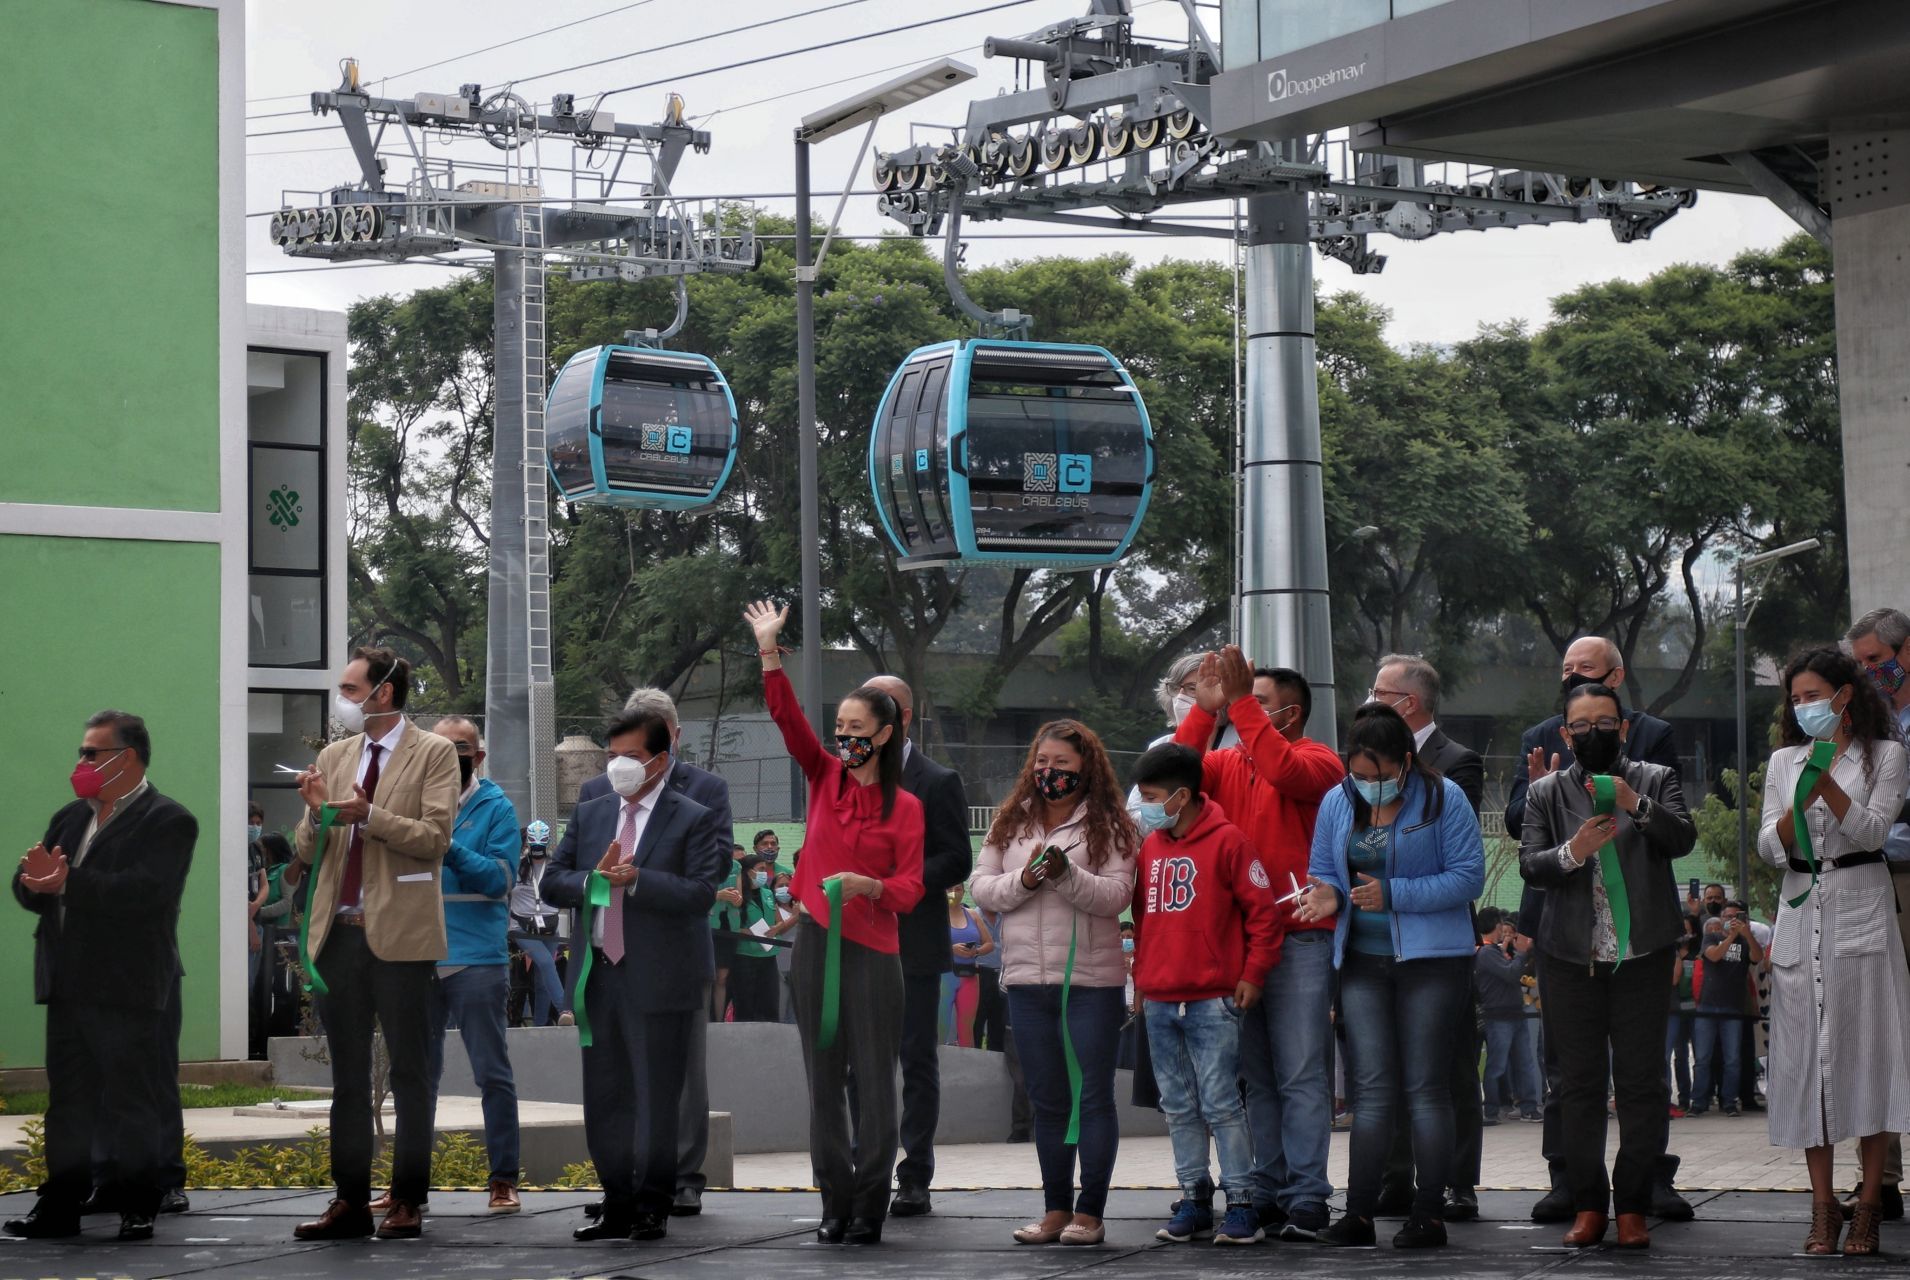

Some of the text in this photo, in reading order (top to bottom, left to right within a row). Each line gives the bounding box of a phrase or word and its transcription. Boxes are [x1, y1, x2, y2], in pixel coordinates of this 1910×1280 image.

[1287, 62, 1367, 97] Doppelmayr
[1147, 858, 1162, 913] RED SOX
[1164, 856, 1198, 912] B
